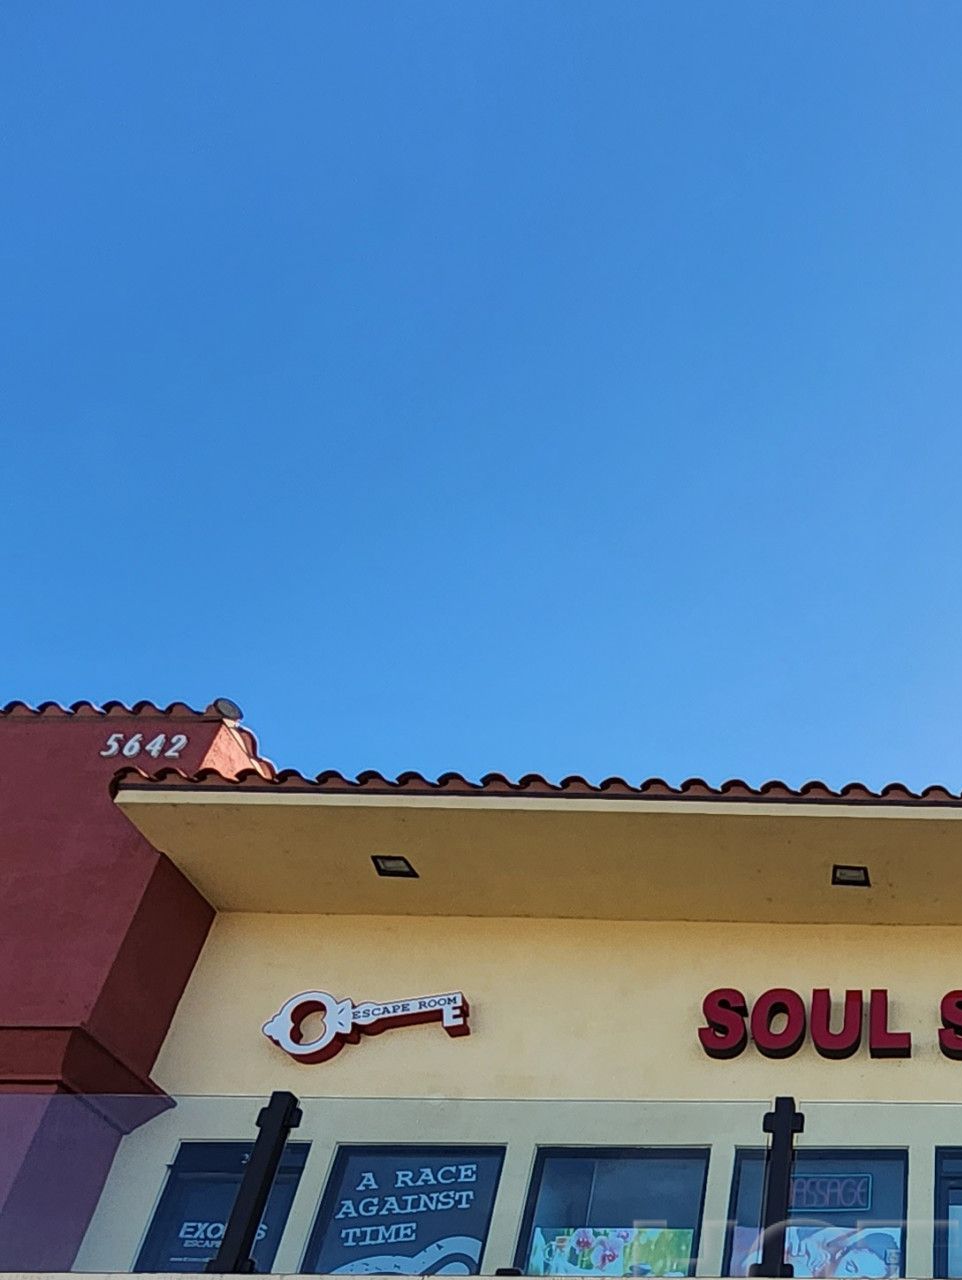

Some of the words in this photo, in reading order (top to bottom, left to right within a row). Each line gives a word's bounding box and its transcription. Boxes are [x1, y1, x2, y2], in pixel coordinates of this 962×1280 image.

[100, 733, 188, 758] 5642
[352, 1003, 411, 1020] ESCAPE
[417, 996, 458, 1010] ROOM
[698, 988, 911, 1060] SOUL
[355, 1172, 379, 1191] A
[394, 1164, 478, 1189] RACE
[335, 1190, 475, 1220] AGAINST
[789, 1178, 868, 1208] ASSAGE
[179, 1221, 268, 1241] EXOS
[340, 1222, 418, 1247] TIME
